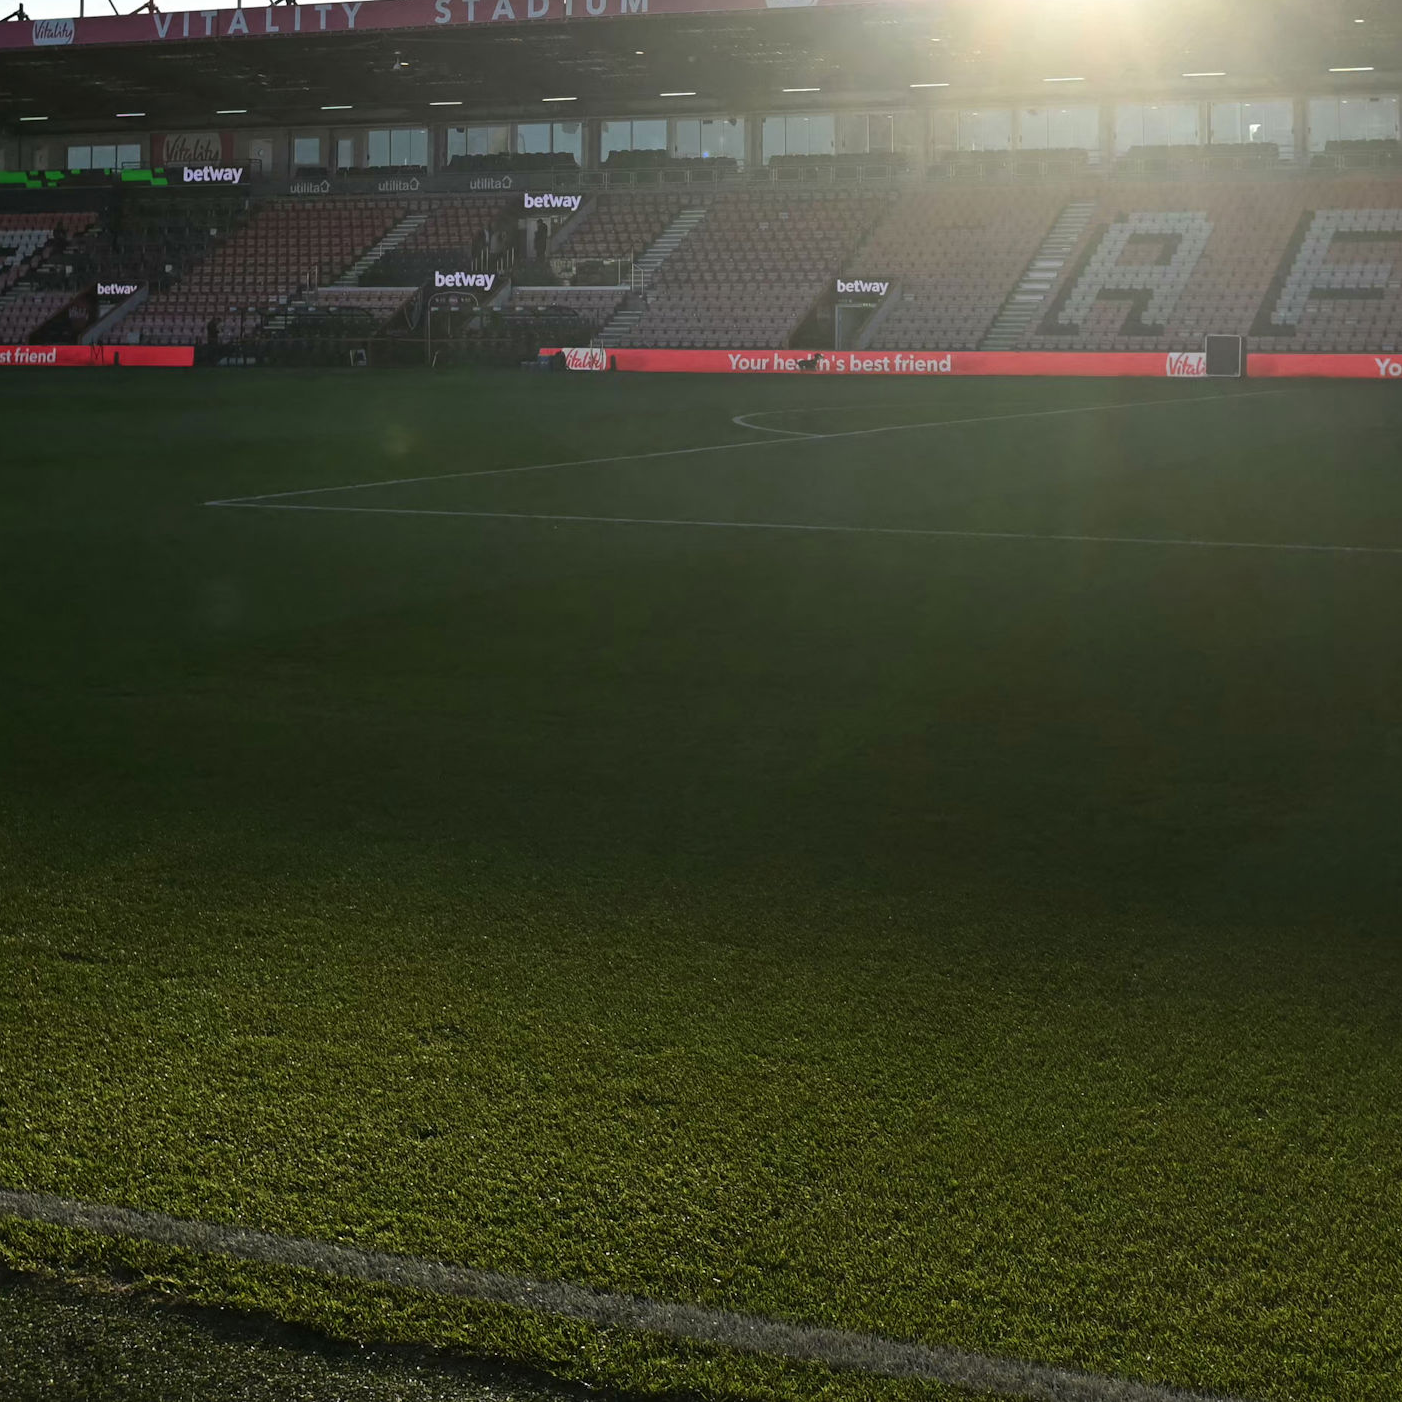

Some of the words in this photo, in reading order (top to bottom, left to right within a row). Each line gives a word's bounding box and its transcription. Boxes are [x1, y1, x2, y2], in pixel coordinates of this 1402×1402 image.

[154, 2, 361, 38] VITALITY
[34, 19, 75, 42] Vitality
[183, 166, 243, 183] betway
[290, 183, 321, 194] utilita
[378, 180, 410, 192] utilita
[470, 178, 501, 189] utilita
[524, 193, 582, 211] betway
[434, 270, 496, 291] betway
[837, 279, 889, 295] betway
[15, 347, 57, 364] friend
[728, 354, 769, 370] Your
[850, 353, 891, 372] best
[894, 353, 951, 373] friend
[1169, 353, 1206, 375] Vitali
